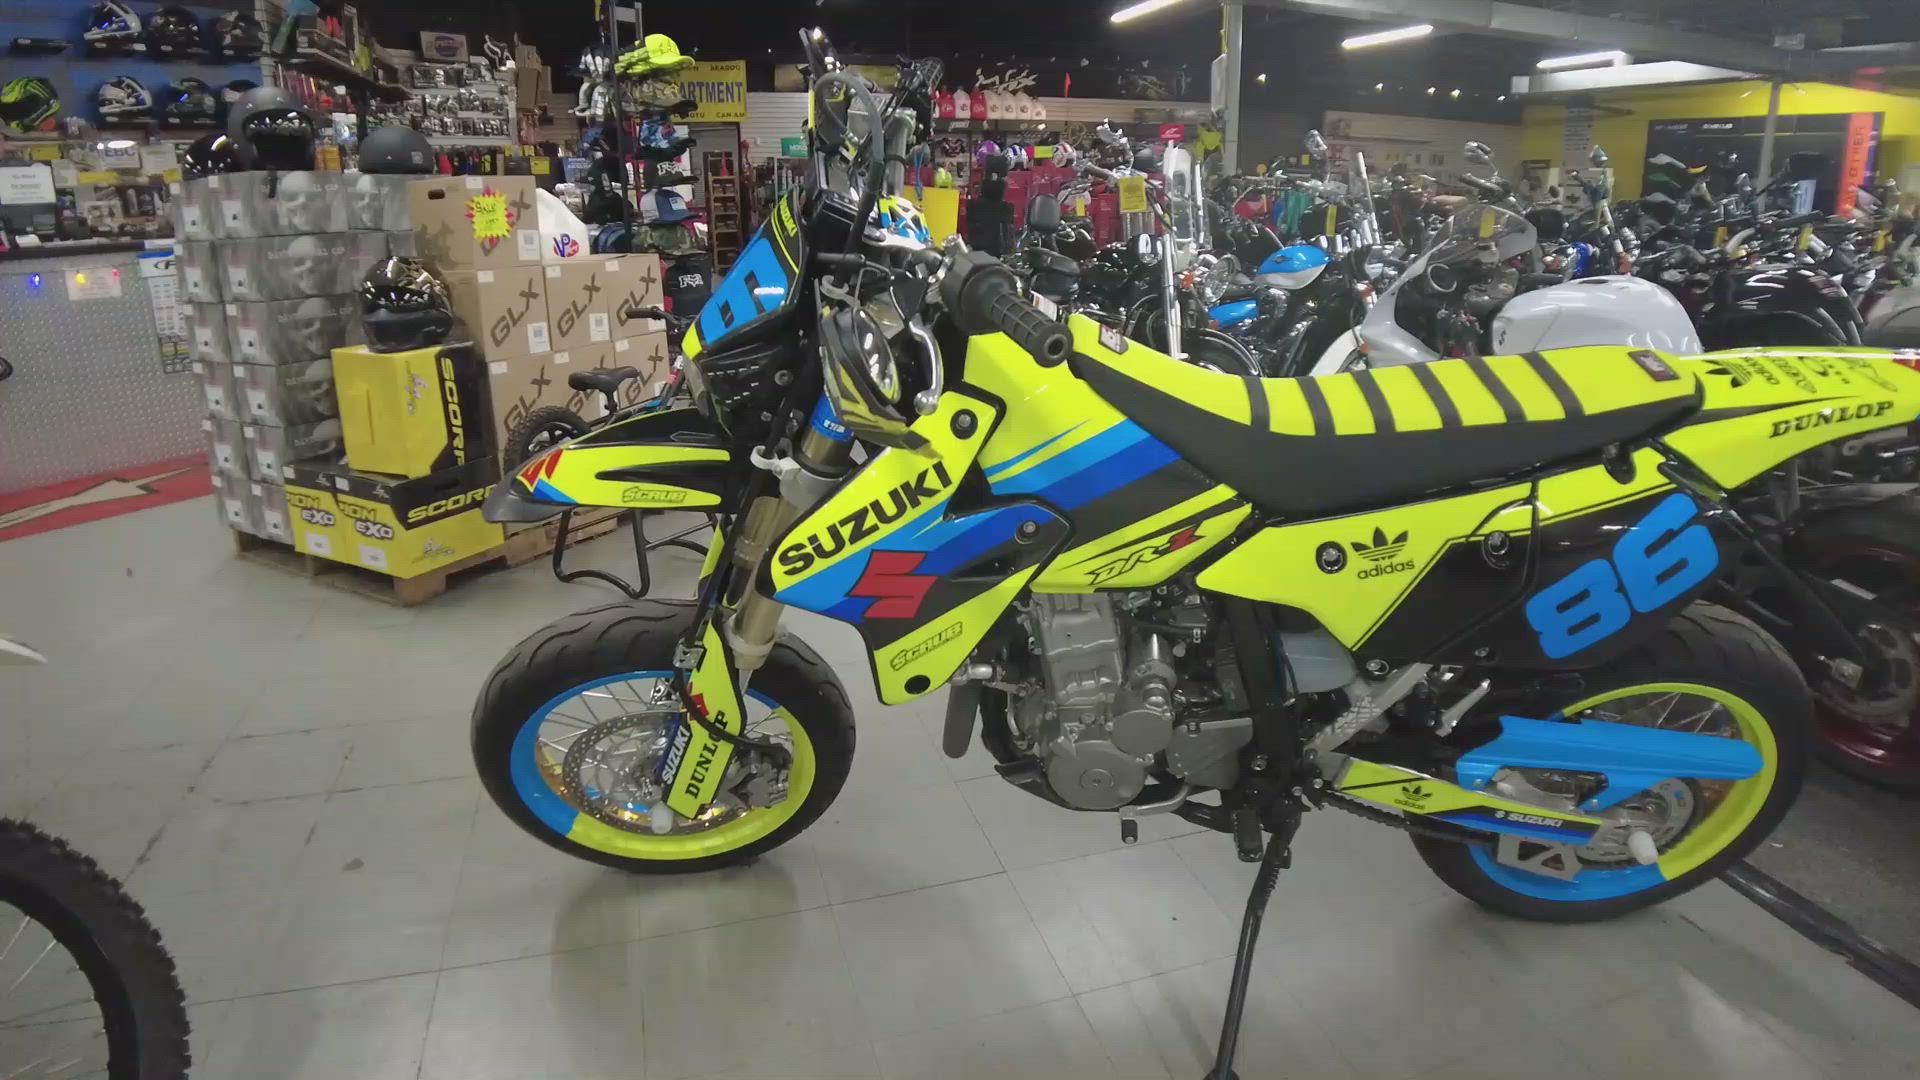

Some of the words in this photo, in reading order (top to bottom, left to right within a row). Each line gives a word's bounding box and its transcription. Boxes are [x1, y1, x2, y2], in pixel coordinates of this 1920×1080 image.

[679, 81, 743, 104] ARTMENT
[490, 277, 540, 347] GLX
[556, 272, 602, 338] GLX
[616, 264, 657, 327] GLX
[625, 344, 665, 405] GLX
[1769, 401, 1894, 439] DUNLOP
[778, 460, 953, 576] SUZUKI
[1357, 558, 1415, 579] adidas
[1525, 492, 1720, 660] 86
[662, 724, 691, 785] SUZUKI
[1507, 814, 1564, 828] SUZUKI
